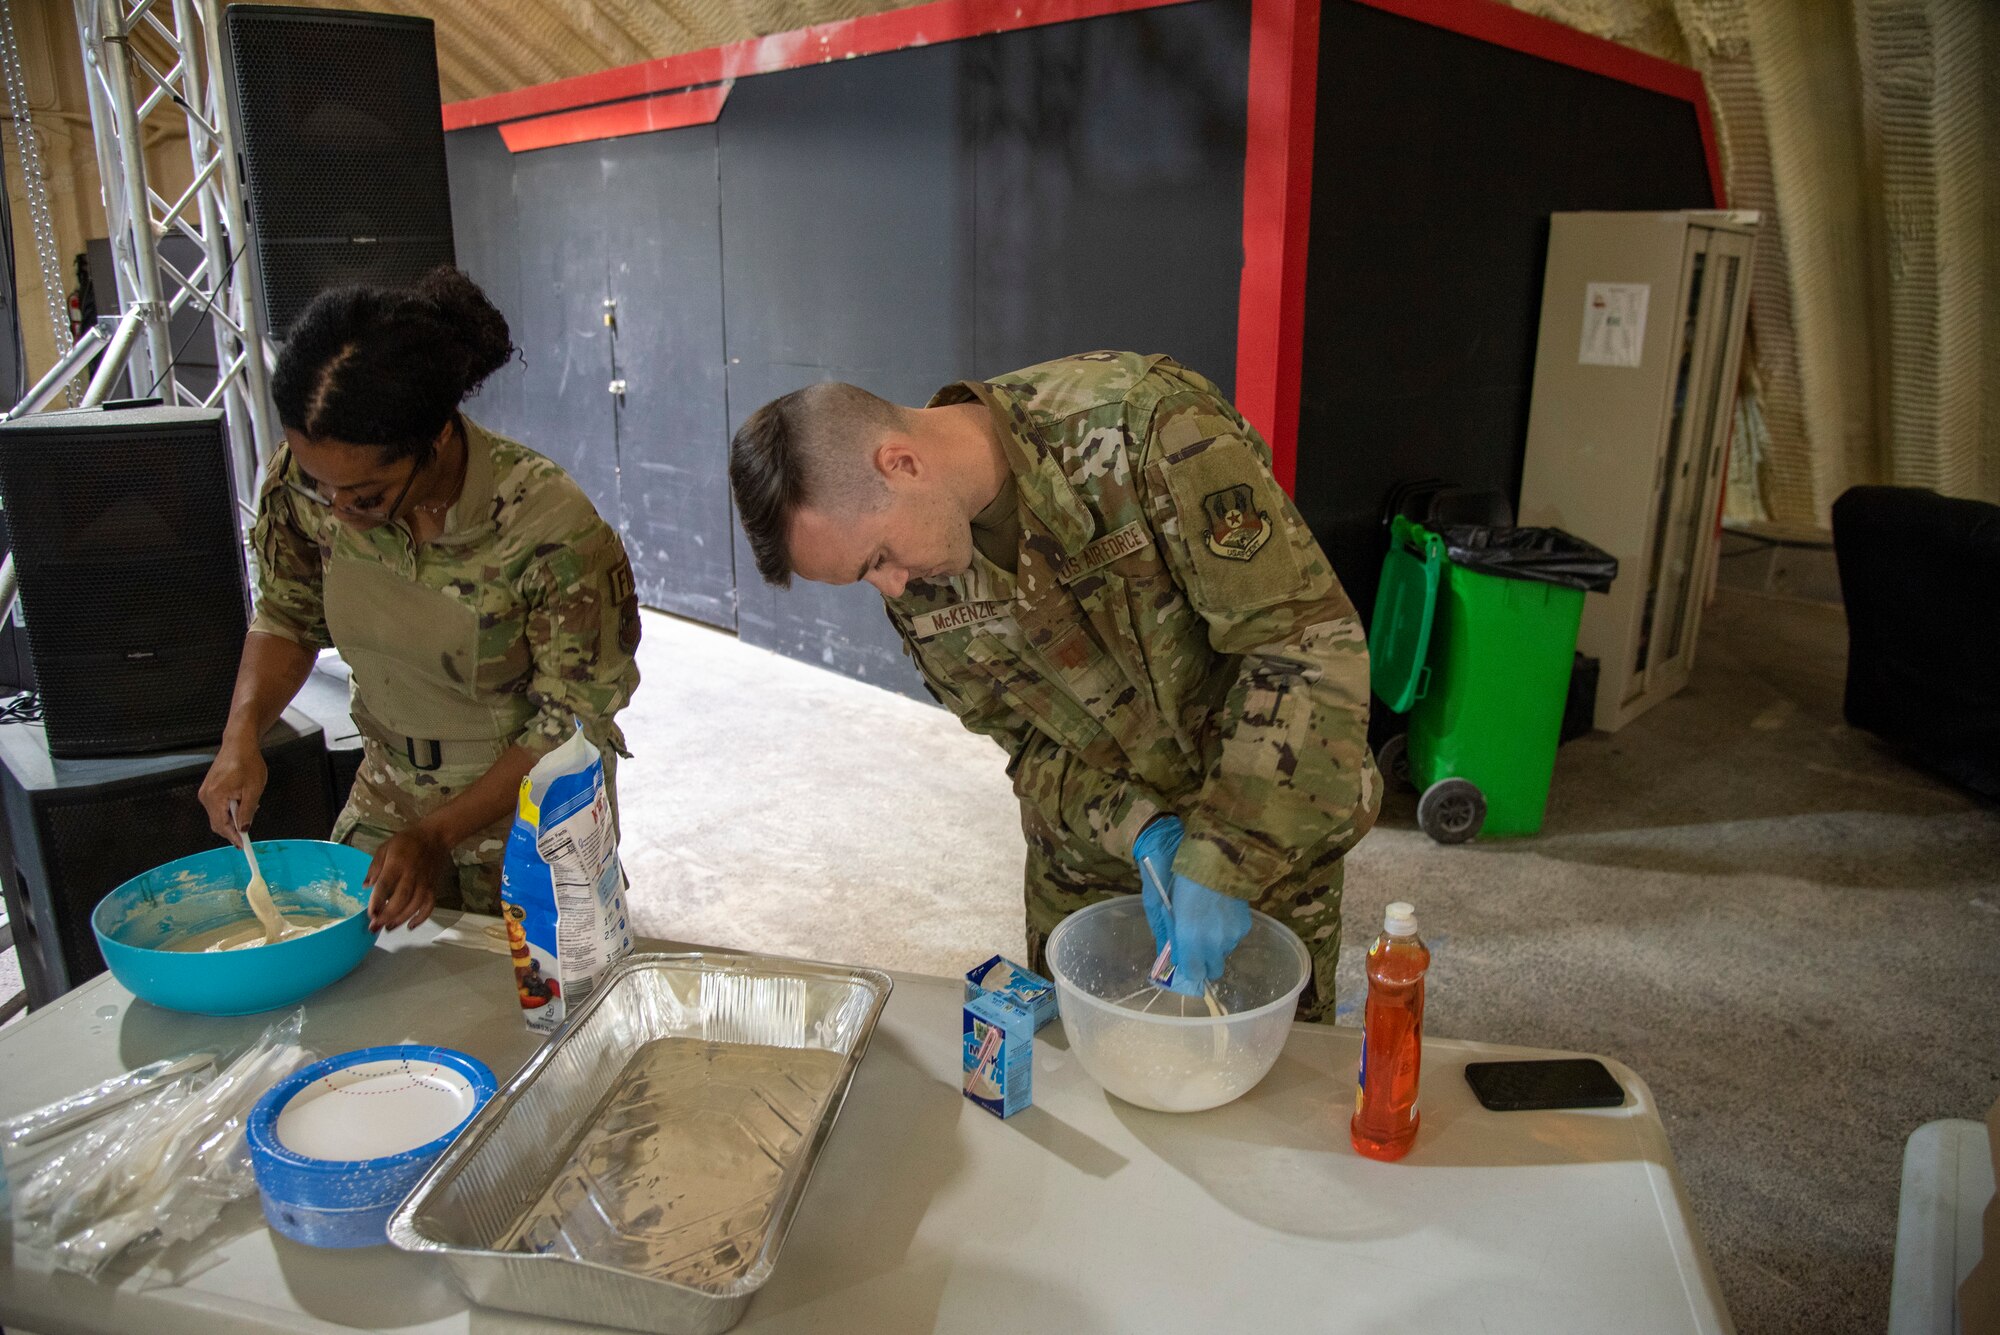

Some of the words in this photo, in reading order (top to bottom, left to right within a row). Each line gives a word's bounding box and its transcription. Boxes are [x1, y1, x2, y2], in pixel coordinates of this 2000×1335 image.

[1082, 545, 1105, 569] AIR
[1101, 527, 1142, 561] FORCE
[931, 601, 998, 631] McKENZIE
[968, 1043, 999, 1069] MK
